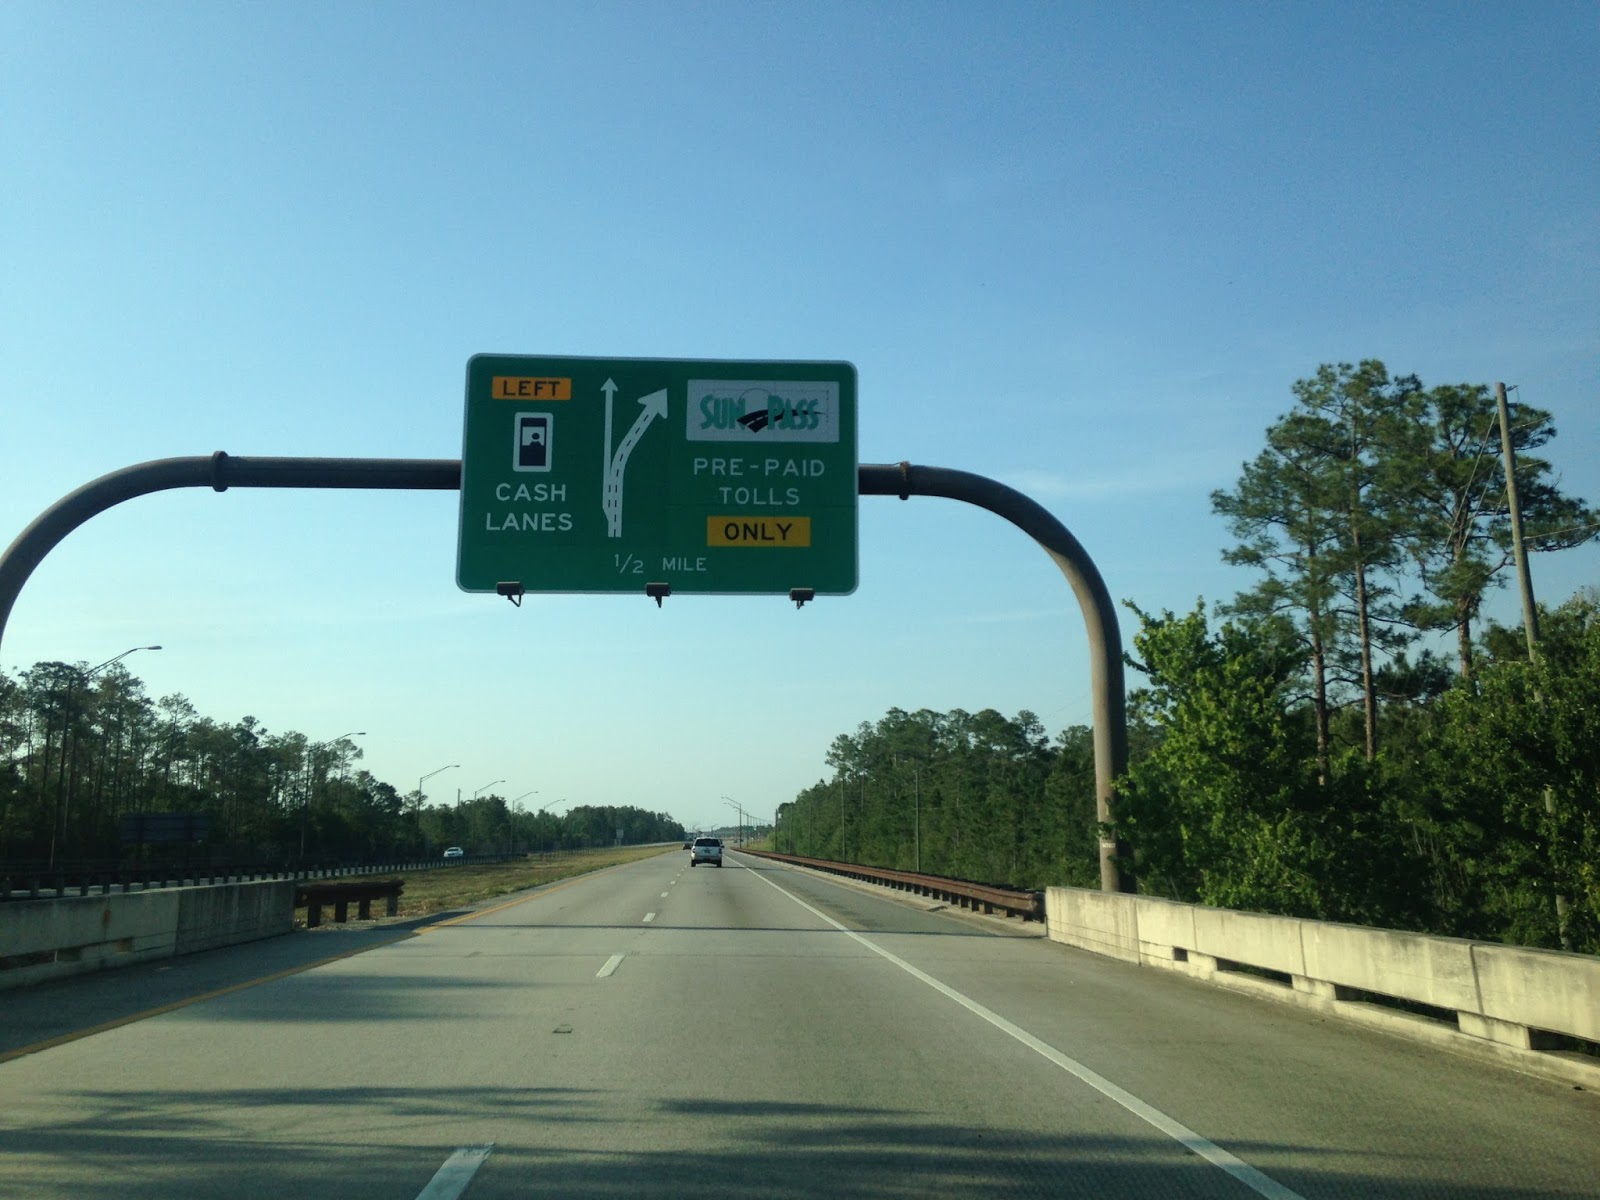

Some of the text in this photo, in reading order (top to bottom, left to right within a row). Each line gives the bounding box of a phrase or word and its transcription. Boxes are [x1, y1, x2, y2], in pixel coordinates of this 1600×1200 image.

[503, 380, 561, 397] LEFT
[693, 458, 825, 477] PRE-PAID
[495, 483, 567, 502] CASH
[719, 487, 800, 506] TOLLS
[486, 512, 573, 531] LANES
[724, 522, 793, 541] ONLY
[614, 553, 707, 574] 1/2 MILE
